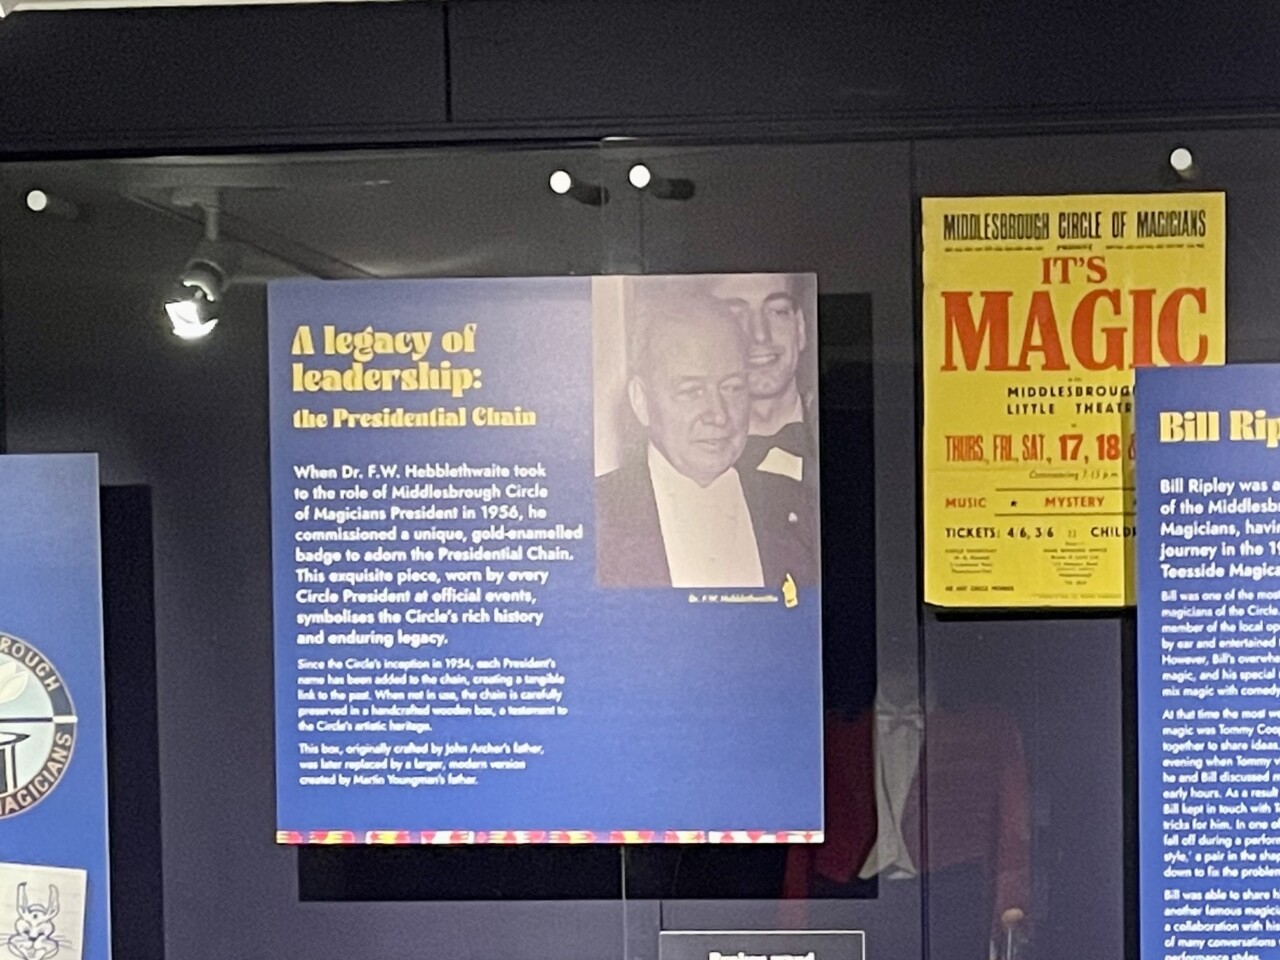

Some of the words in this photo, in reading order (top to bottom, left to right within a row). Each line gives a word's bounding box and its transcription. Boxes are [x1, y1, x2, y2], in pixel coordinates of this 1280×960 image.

[943, 212, 1050, 241] MIDDLESBROUGH
[1058, 210, 1102, 240] CIRCLE
[1111, 210, 1127, 239] OF
[1136, 209, 1206, 239] MAGICIANS
[1041, 255, 1108, 285] IT'S
[940, 287, 1208, 372] MAGIC
[291, 325, 315, 356] A
[323, 325, 433, 361] legacy
[440, 322, 479, 355] of
[292, 361, 483, 398] leadership:
[1007, 384, 1136, 398] MIDDLESBROUG
[293, 409, 328, 428] the
[333, 406, 467, 428] Presidential
[470, 406, 537, 427] Chain
[1007, 402, 1055, 415] LITTLE
[1075, 401, 1133, 415] THEATR
[1159, 411, 1220, 443] Bill
[1095, 432, 1122, 461] 18
[293, 463, 338, 479] When
[341, 464, 364, 479] Dr.
[367, 464, 401, 479] F.W.
[404, 462, 511, 479] Hebblethwaite
[512, 461, 548, 478] took
[294, 487, 309, 500] to
[312, 484, 336, 500] the
[339, 484, 369, 500] role
[372, 483, 388, 500] of
[391, 483, 502, 503] Middlesbrough
[504, 481, 550, 499] Circle
[1160, 477, 1184, 494] Bill
[1188, 476, 1235, 497] Ripley
[1238, 480, 1269, 492] was
[945, 496, 986, 509] MUSIC
[1044, 495, 1106, 509] MYSTERY
[1159, 498, 1177, 515] of
[1179, 498, 1204, 515] the
[294, 504, 310, 521] of
[313, 506, 387, 524] Magicians
[390, 503, 459, 521] President
[462, 504, 477, 520] in
[480, 504, 524, 522] 1956,
[527, 503, 548, 520] he
[294, 525, 397, 542] commissioned
[400, 530, 410, 541] a
[413, 526, 468, 544] unique,
[471, 521, 585, 545] gold-enamelled
[1160, 520, 1241, 540] Magicians,
[295, 546, 342, 566] badge
[345, 549, 361, 562] to
[363, 546, 408, 562] adorn
[410, 545, 435, 562] the
[437, 542, 524, 562] Presidential
[526, 544, 575, 561] Chain.
[1159, 542, 1218, 562] journey
[1221, 541, 1236, 556] in
[1239, 539, 1264, 556] the
[295, 567, 326, 583] This
[328, 567, 394, 586] exquisite
[396, 567, 442, 586] piece,
[444, 570, 483, 582] worn
[485, 565, 505, 586] by
[506, 570, 550, 586] every
[1160, 561, 1225, 579] Teesside
[295, 587, 339, 604] Circle
[342, 587, 411, 603] President
[413, 589, 429, 603] at
[431, 586, 482, 603] official
[484, 588, 537, 605] events,
[296, 608, 375, 627] symbolises
[377, 608, 402, 624] the
[404, 607, 459, 624] Circle's
[461, 607, 491, 623] rich
[493, 607, 544, 627] history
[296, 629, 325, 645] and
[327, 628, 395, 649] enduring
[396, 628, 449, 649] legacy.
